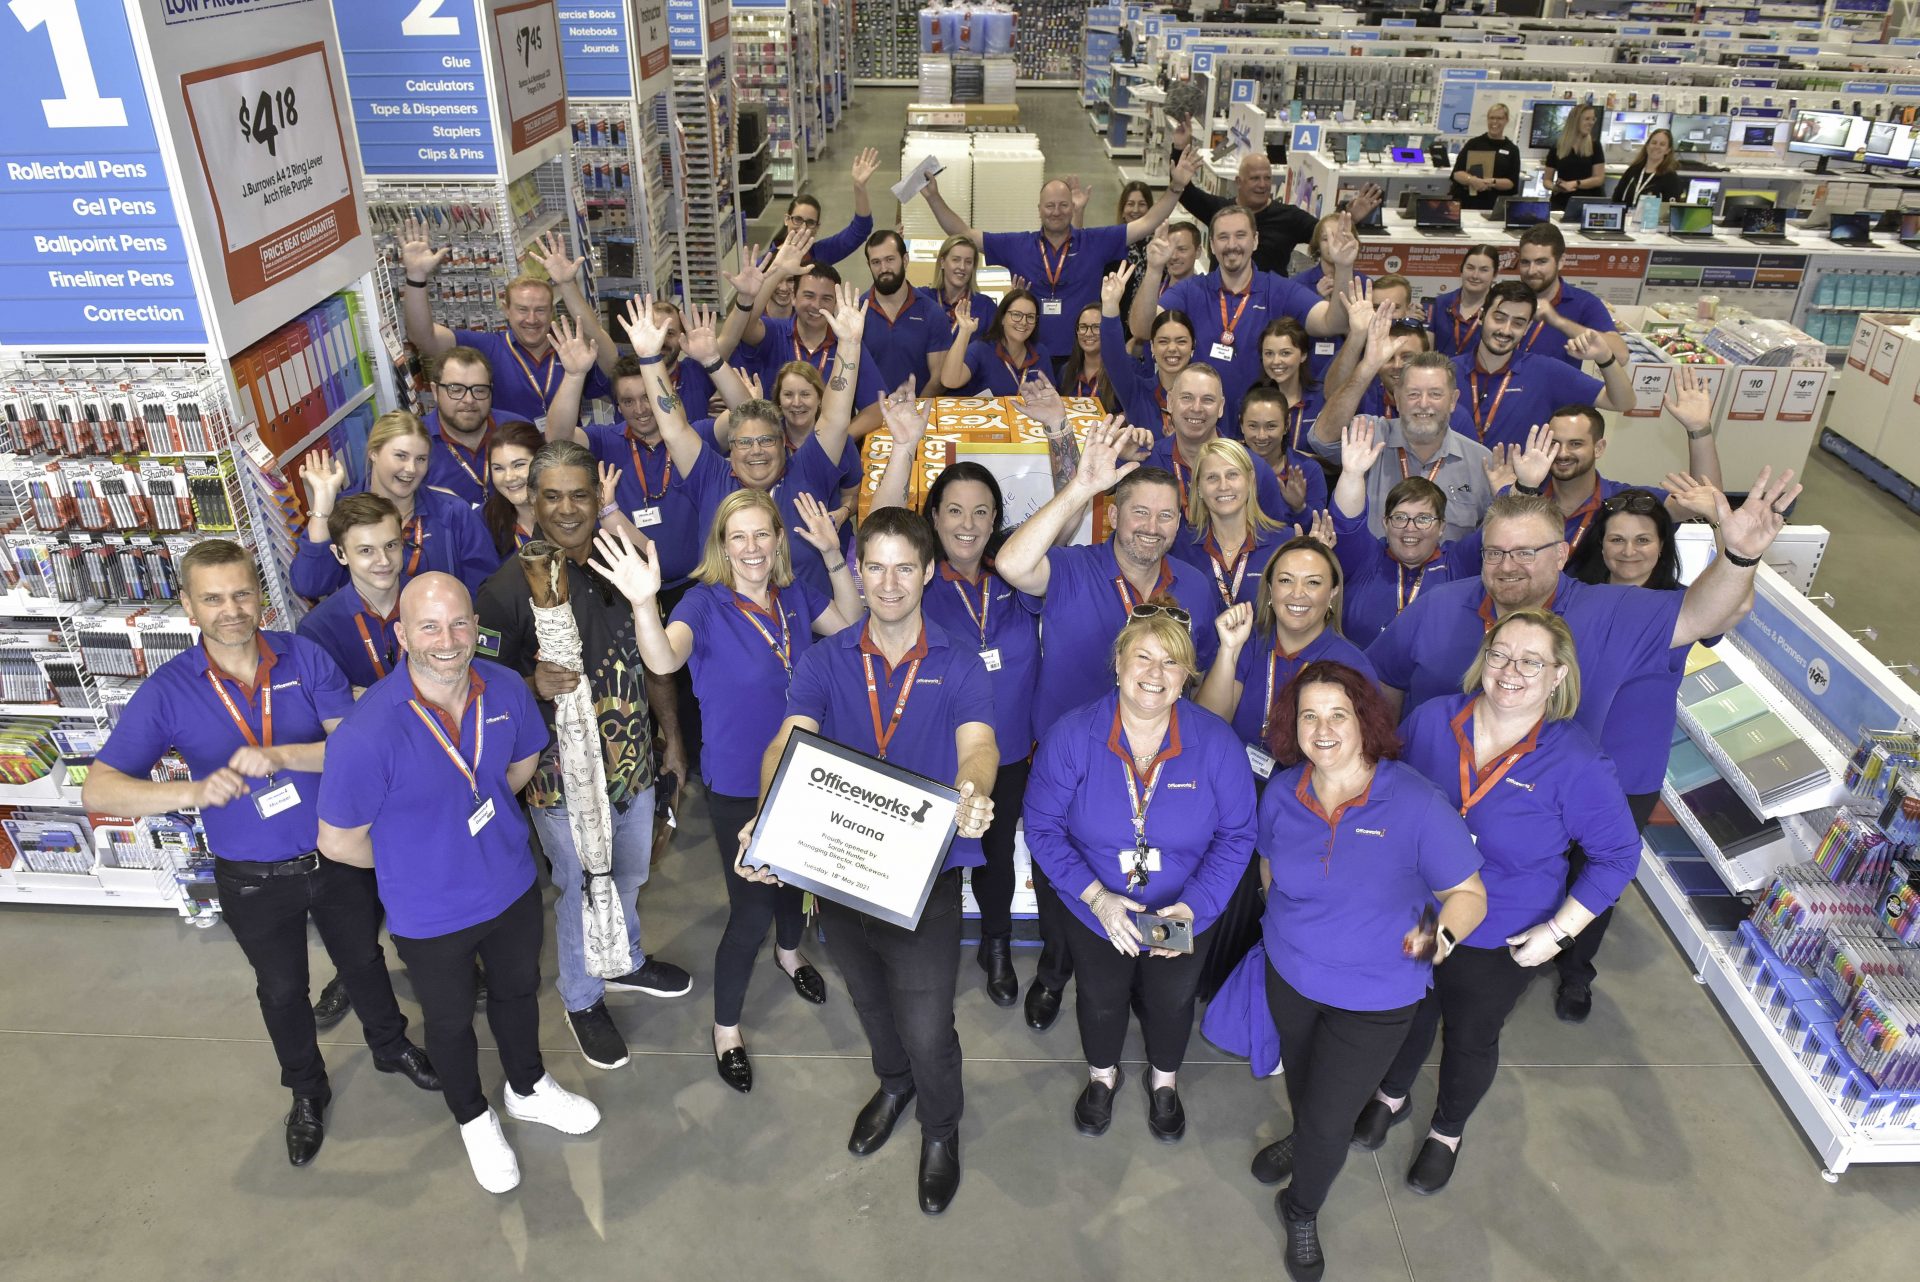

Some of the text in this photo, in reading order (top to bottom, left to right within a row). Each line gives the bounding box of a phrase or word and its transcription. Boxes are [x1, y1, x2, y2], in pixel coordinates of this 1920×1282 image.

[588, 10, 616, 19] Books
[569, 27, 617, 36] Notebooks
[582, 44, 619, 53] Journals
[1170, 38, 1178, 47] D
[442, 56, 471, 68] Glue
[1197, 57, 1207, 68] C
[406, 80, 475, 92] Calculators
[1238, 86, 1247, 97] B
[371, 103, 478, 117] Tape & Dispensers
[432, 126, 481, 139] Staplers
[1298, 131, 1312, 145] A
[418, 148, 484, 162] Clips & Pins
[7, 160, 147, 181] Rollerball Pens
[276, 168, 286, 182] A4
[286, 166, 292, 178] 2
[291, 163, 307, 175] Ring
[307, 155, 323, 170] Lever
[264, 174, 313, 206] Arch File Purple
[72, 198, 156, 216] Gel Pens
[34, 235, 167, 256] Ballpoint Pens
[262, 241, 285, 262] PRICE
[283, 234, 300, 252] BEAT
[299, 215, 336, 242] GUARANTEE
[49, 270, 174, 288] Fineliner Pens
[84, 305, 184, 322] Correction
[136, 391, 167, 404] Sharpie
[171, 390, 200, 403] Sharpie
[939, 414, 1010, 429] Yes
[94, 468, 126, 482] Sharpie
[142, 468, 175, 482] Sharpie
[1750, 611, 1807, 668] Diaries & Planners
[811, 767, 910, 817] Officeworks
[830, 810, 885, 841] Warana
[821, 832, 877, 859] Proudly opened by
[827, 843, 866, 861] Sarah Hunter
[797, 839, 828, 857] Managing
[855, 861, 890, 880] Officeworks
[836, 862, 846, 870] On
[842, 876, 855, 886] May
[855, 881, 870, 891] 2021
